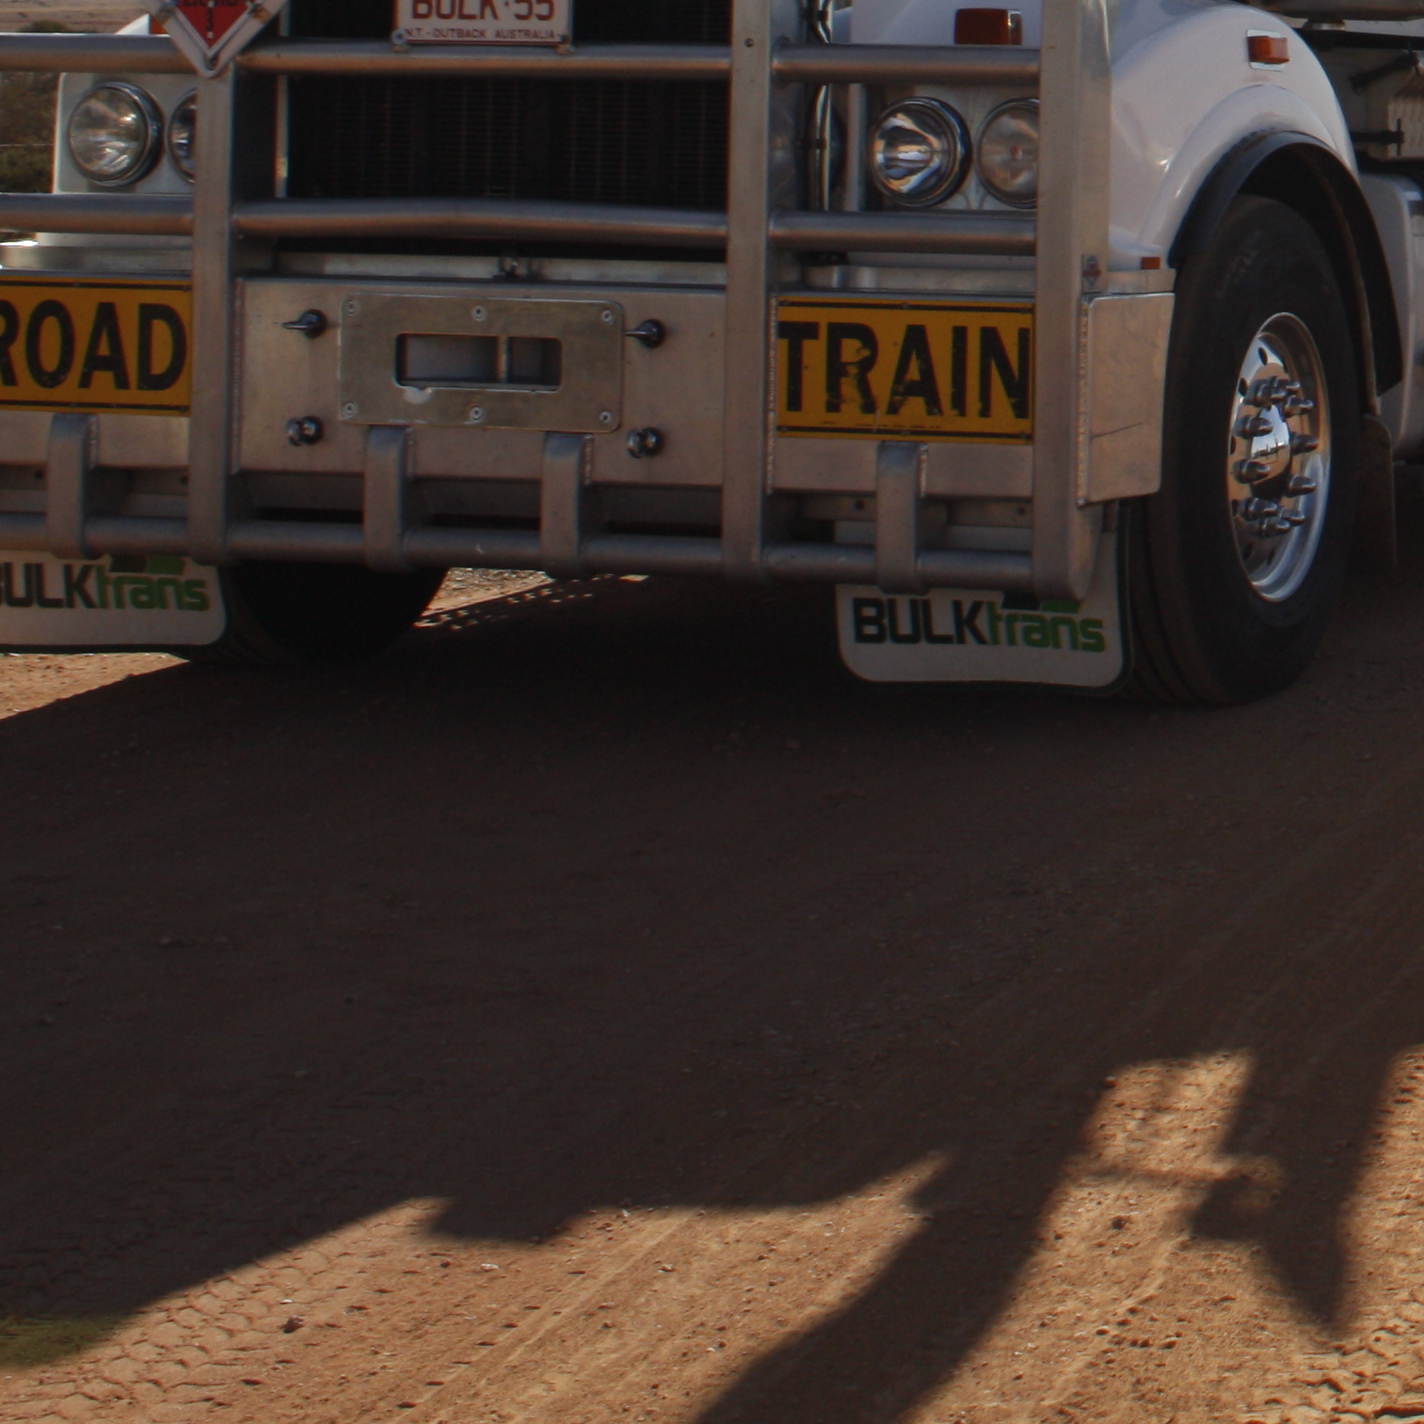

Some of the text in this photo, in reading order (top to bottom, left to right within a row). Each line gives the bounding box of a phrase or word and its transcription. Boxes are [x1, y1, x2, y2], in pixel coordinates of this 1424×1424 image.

[433, 28, 488, 39] OUTBACK
[495, 29, 555, 40] AUSTRALIA
[0, 299, 188, 391] ROAD
[777, 320, 1032, 420] TRAIN
[0, 562, 210, 612] ULKtrans
